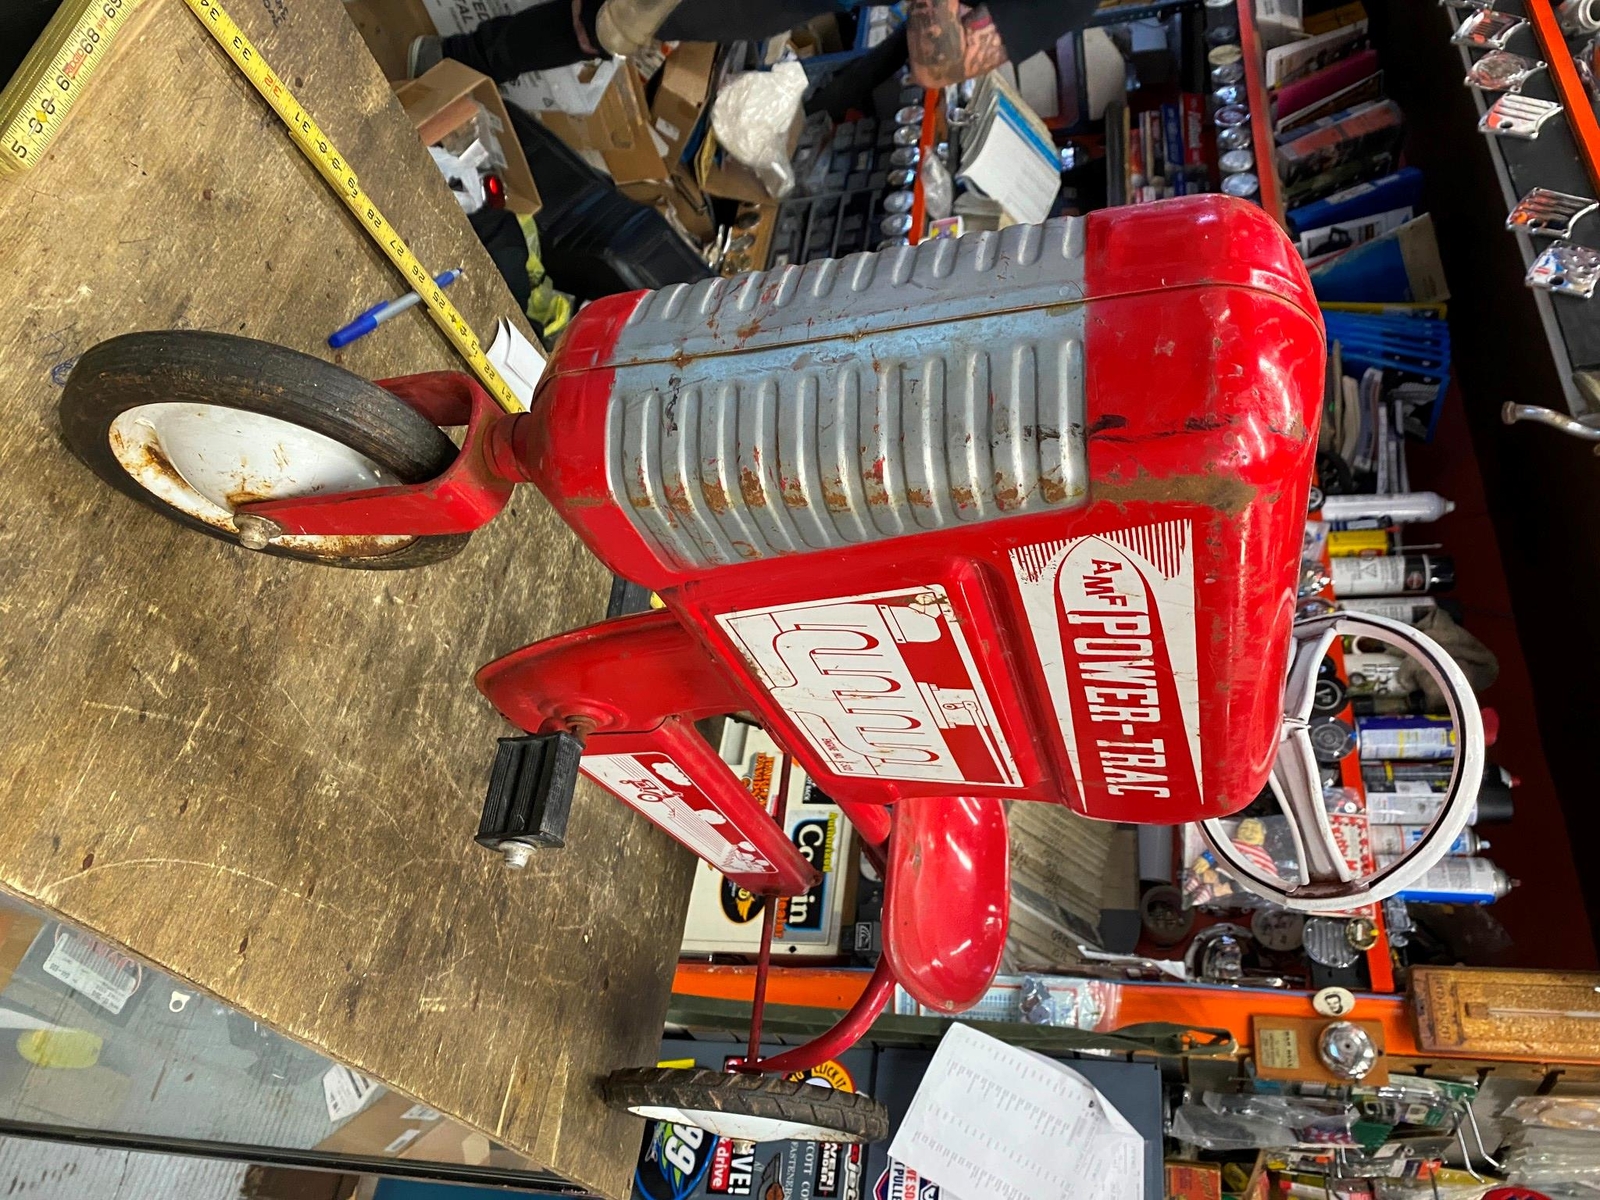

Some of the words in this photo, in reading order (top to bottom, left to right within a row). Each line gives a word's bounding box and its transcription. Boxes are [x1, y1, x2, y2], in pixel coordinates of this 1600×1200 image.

[80, 27, 100, 55] 68
[233, 36, 251, 60] 33
[63, 48, 85, 77] RIDGID
[265, 74, 282, 98] 32
[295, 112, 310, 133] 31
[367, 209, 381, 228] 28
[390, 239, 404, 257] 27
[412, 265, 425, 283] 26
[433, 291, 446, 309] 25
[484, 364, 495, 380] 22
[502, 387, 511, 402] 21
[1082, 559, 1128, 608] AMF
[1067, 613, 1171, 798] POWER-TRAC
[823, 812, 838, 873] Authorized
[789, 824, 824, 924] Coin
[774, 896, 789, 938] ealer
[814, 1064, 839, 1080] CLICK
[835, 1077, 846, 1088] IT
[665, 1124, 703, 1176] 99
[712, 1146, 729, 1188] drive
